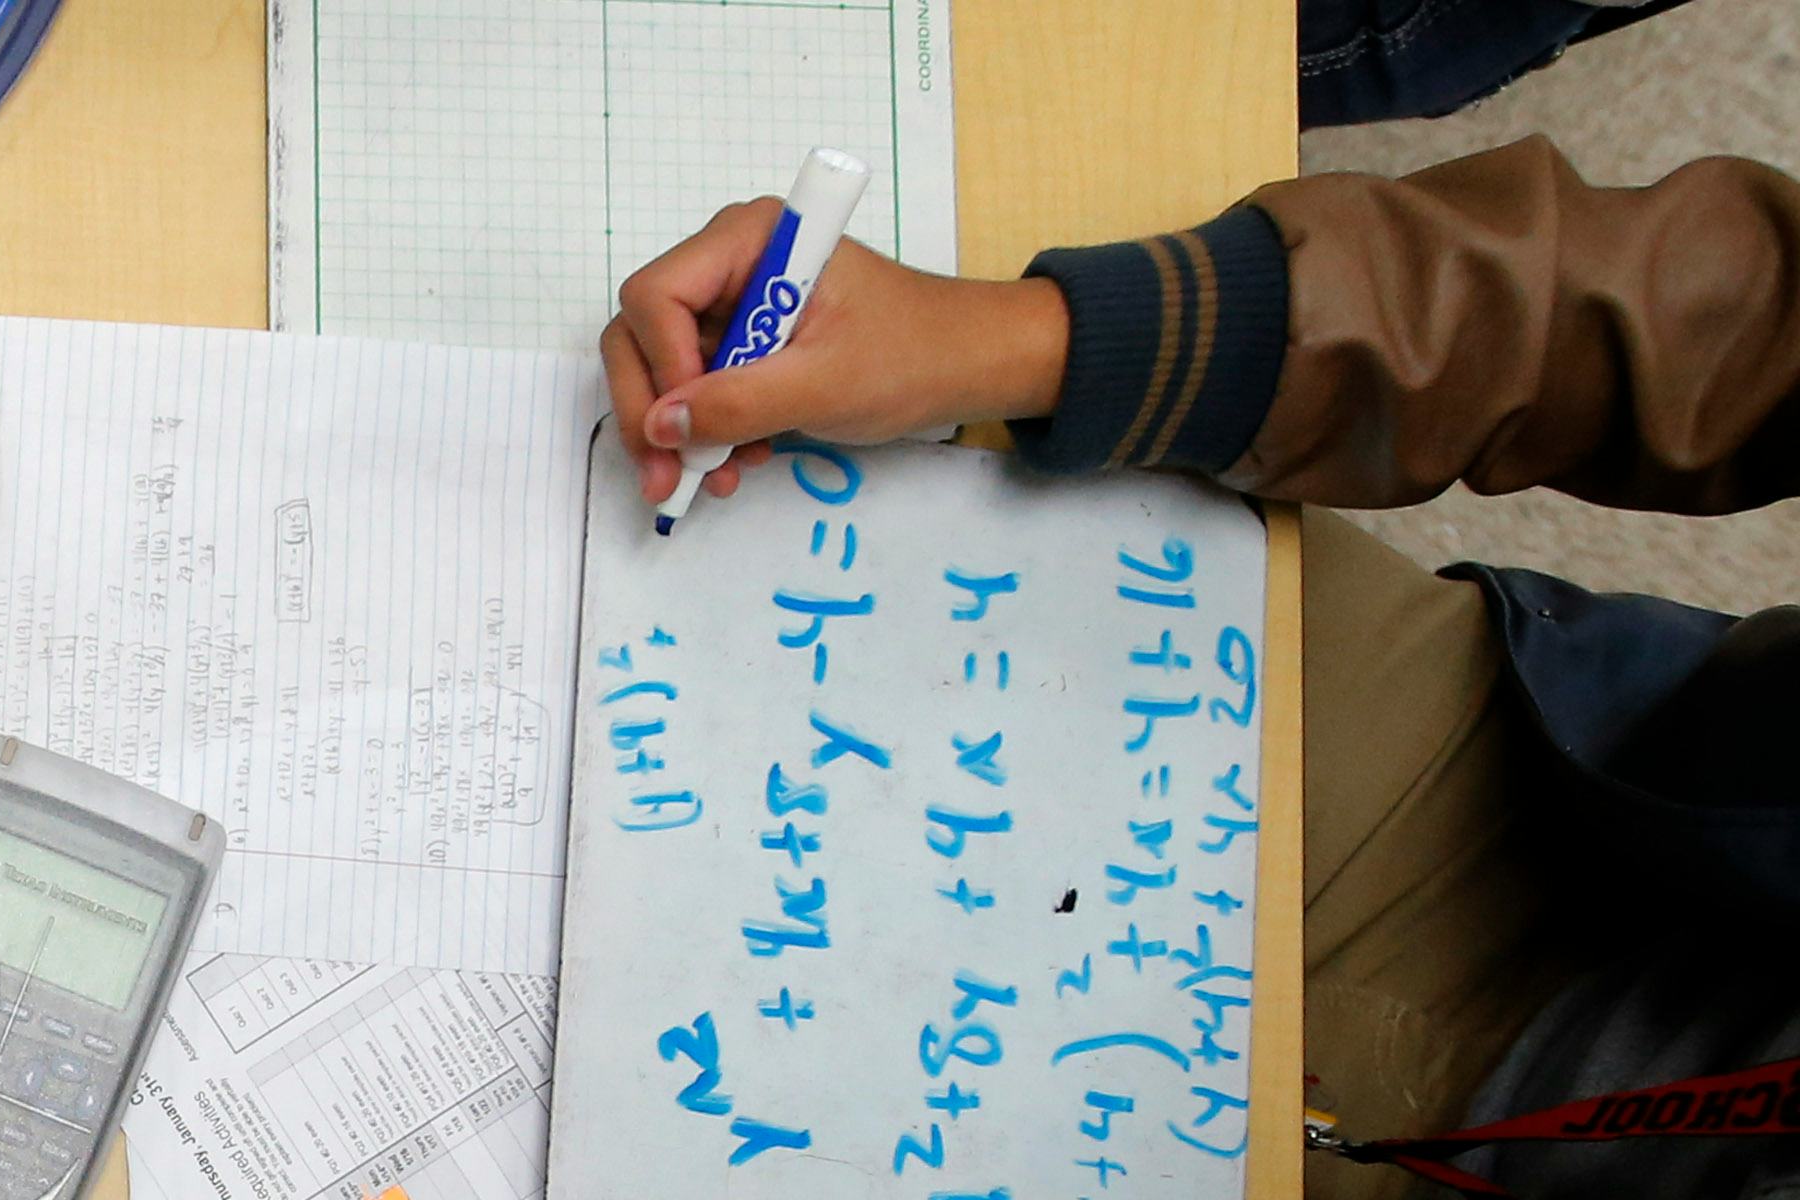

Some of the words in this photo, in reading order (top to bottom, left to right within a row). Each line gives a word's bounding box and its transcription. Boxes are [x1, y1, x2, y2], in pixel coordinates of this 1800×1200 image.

[157, 1095, 196, 1145] January
[193, 1090, 238, 1150] Activities
[387, 1153, 404, 1174] Wed
